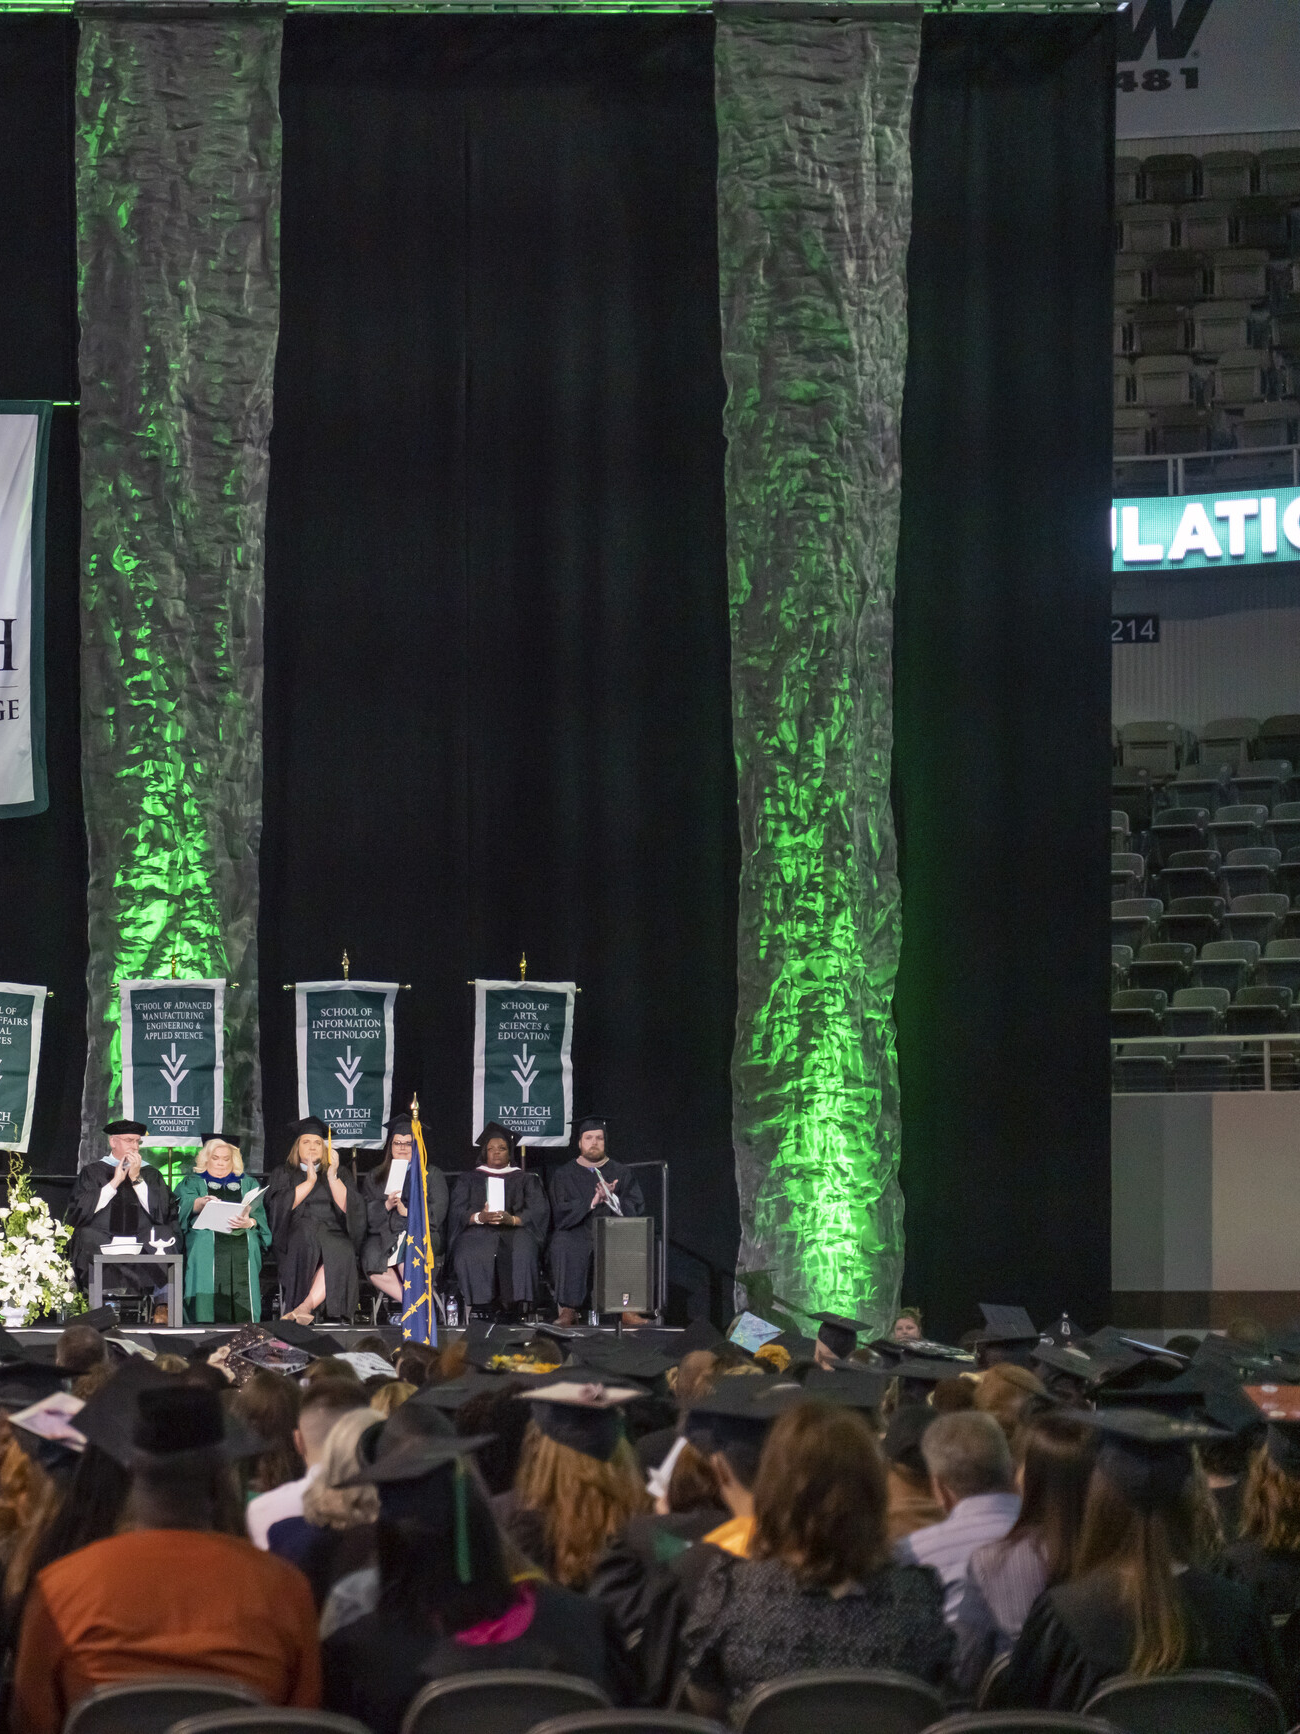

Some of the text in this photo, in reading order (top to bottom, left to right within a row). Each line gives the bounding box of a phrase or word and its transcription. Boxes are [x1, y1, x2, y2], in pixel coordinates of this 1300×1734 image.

[1116, 67, 1199, 92] 481
[1111, 496, 1300, 562] LATI
[1111, 619, 1156, 641] 214
[502, 1002, 537, 1010] SCHOOL
[6, 1007, 17, 1015] OF
[321, 1008, 372, 1016] SCHOOL OF
[513, 1012, 538, 1020] ARTS,
[147, 1022, 193, 1030] ENGINEERING
[312, 1019, 381, 1028] INFORMATION
[499, 1022, 541, 1030] SCIENCES
[144, 1032, 172, 1040] APPLIED
[313, 1031, 380, 1039] TECHNOLOGY
[498, 1032, 550, 1040] EDUCATION
[149, 1106, 199, 1115] IVY TECH
[324, 1109, 371, 1119] IVY TECH
[499, 1106, 551, 1116] IVY TECH
